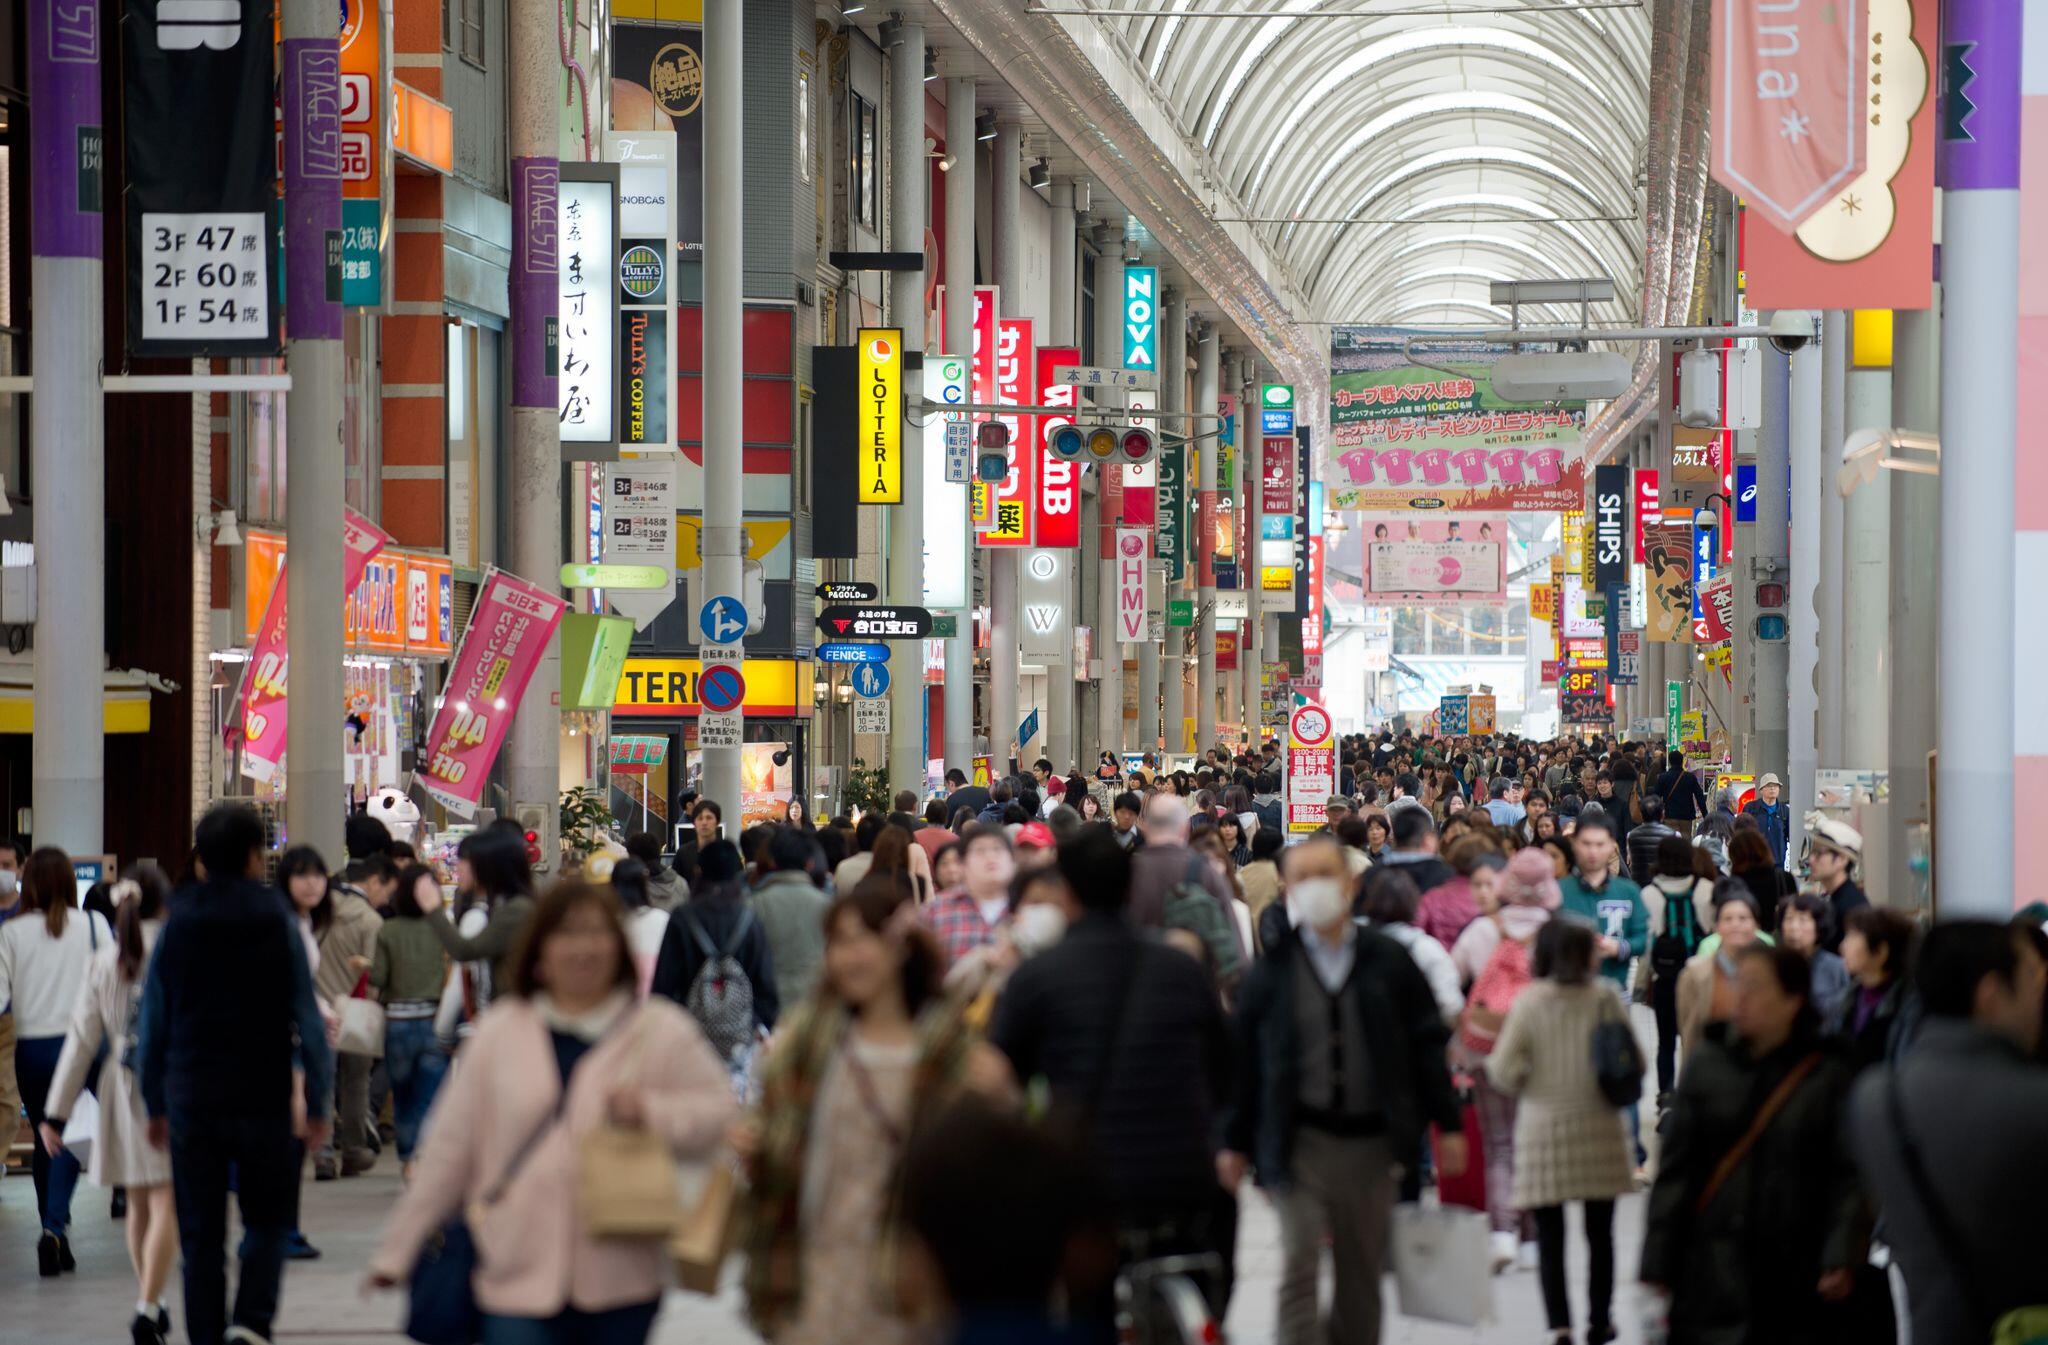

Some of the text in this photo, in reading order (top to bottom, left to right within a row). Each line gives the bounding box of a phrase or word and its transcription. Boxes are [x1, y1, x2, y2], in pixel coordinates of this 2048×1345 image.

[307, 130, 338, 172] 577
[154, 227, 187, 253] 3F
[532, 234, 558, 272] 577
[154, 263, 187, 289] 2F
[623, 264, 660, 276] TULLY'S
[155, 299, 188, 325] 1F
[1127, 274, 1152, 365] NOVA
[631, 313, 648, 441] TULLY'S COFFEE
[1066, 369, 1137, 385] 本通7番
[872, 367, 888, 494] LOTTERIA
[1386, 409, 1574, 443] レディースピンクユニフォーム
[948, 426, 958, 457] 自転車
[959, 426, 968, 457] 歩行者
[952, 458, 963, 479] 専用
[1672, 451, 1708, 466] ひろしま
[616, 481, 630, 493] 3F
[1263, 477, 1292, 488] コミック
[1672, 489, 1693, 502] 1F
[615, 521, 630, 533] 2F
[991, 504, 1020, 535] 薬
[1599, 493, 1621, 564] SHIPS
[1122, 559, 1143, 638] HMV
[853, 620, 918, 634] 谷口宝石
[702, 650, 741, 659] 自転車を除く
[826, 650, 867, 660] FENICE
[621, 672, 699, 703] TERI
[1570, 673, 1593, 690] 3F
[1294, 756, 1328, 766] 自転車
[1597, 899, 1632, 937] T
